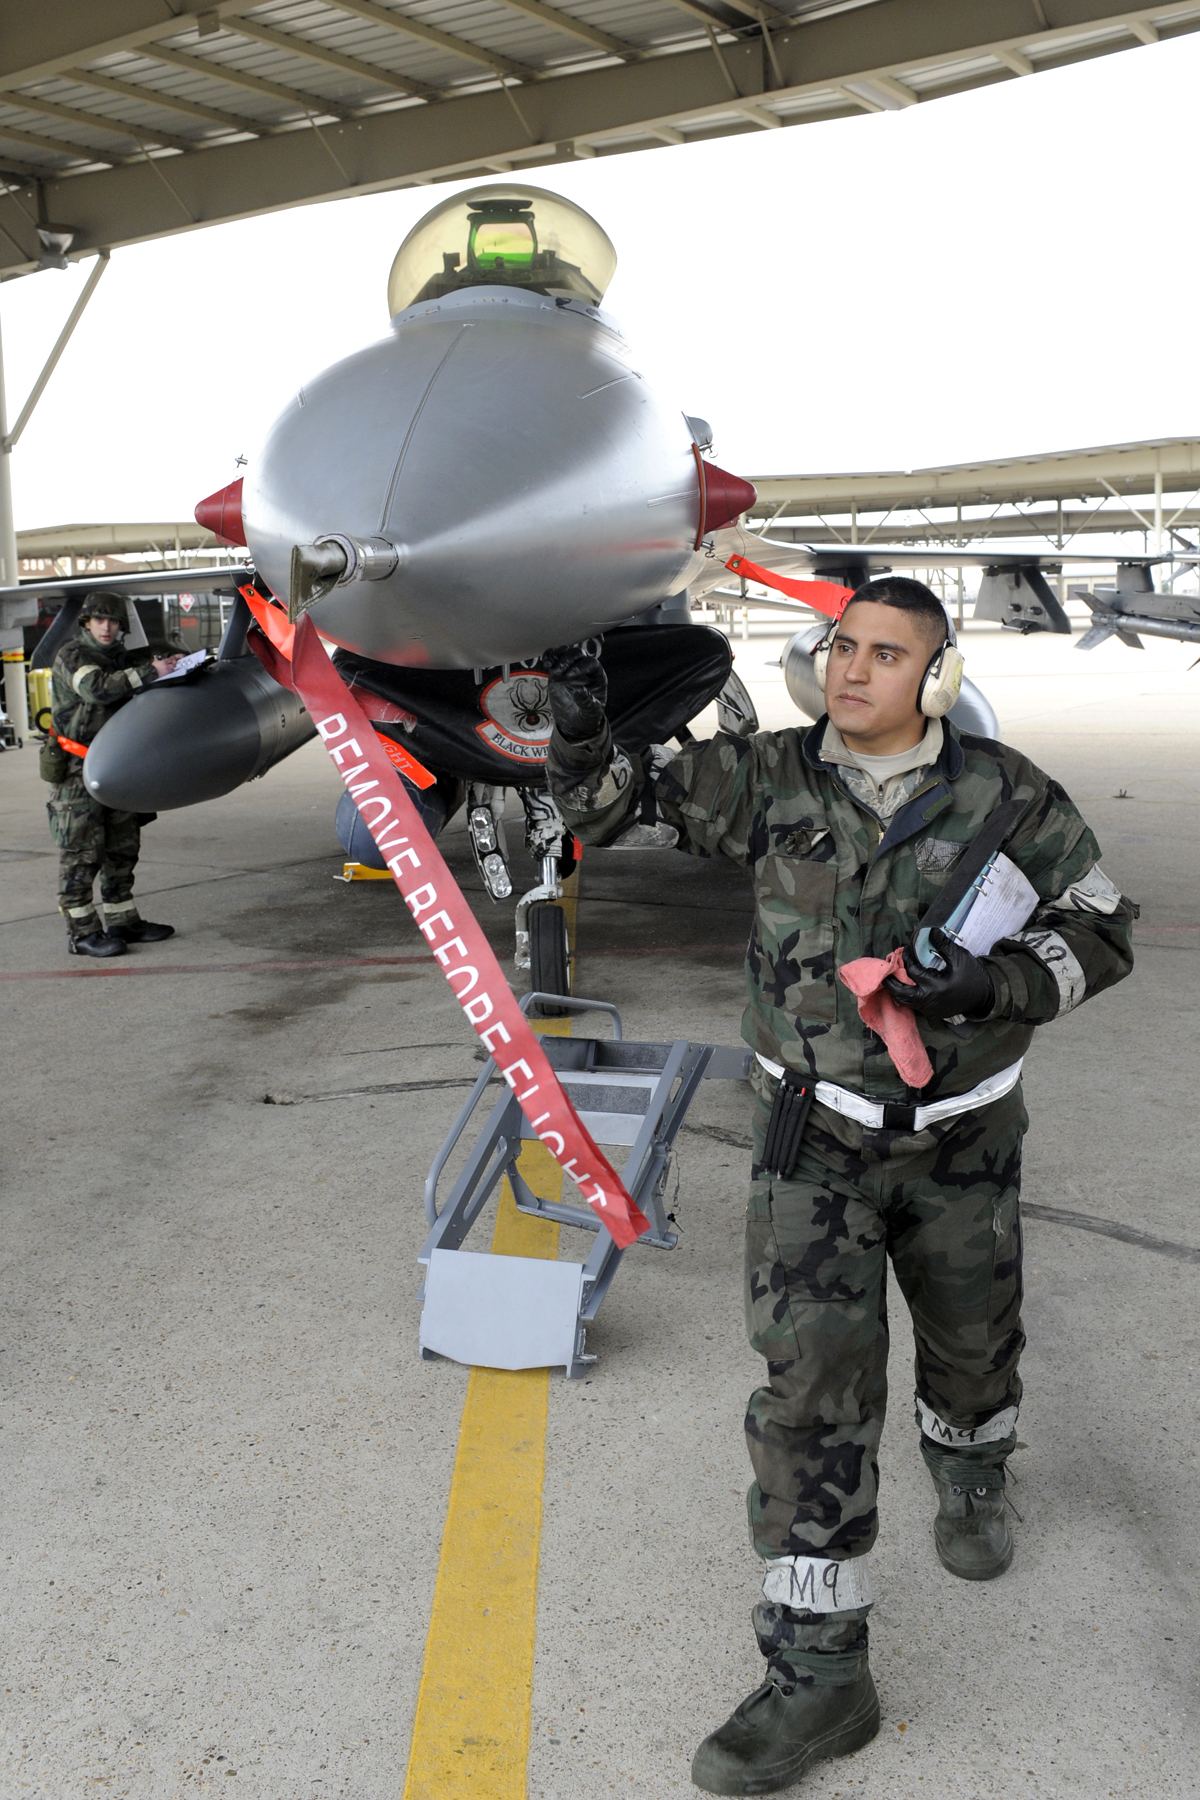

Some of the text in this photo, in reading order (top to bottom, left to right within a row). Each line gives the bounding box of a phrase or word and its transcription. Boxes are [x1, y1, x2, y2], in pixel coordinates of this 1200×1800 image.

[492, 733, 548, 757] BLACK WI
[315, 712, 422, 879] REMOVE
[404, 882, 512, 1053] BEFORE
[931, 1417, 977, 1443] M9
[789, 1562, 839, 1608] M9
